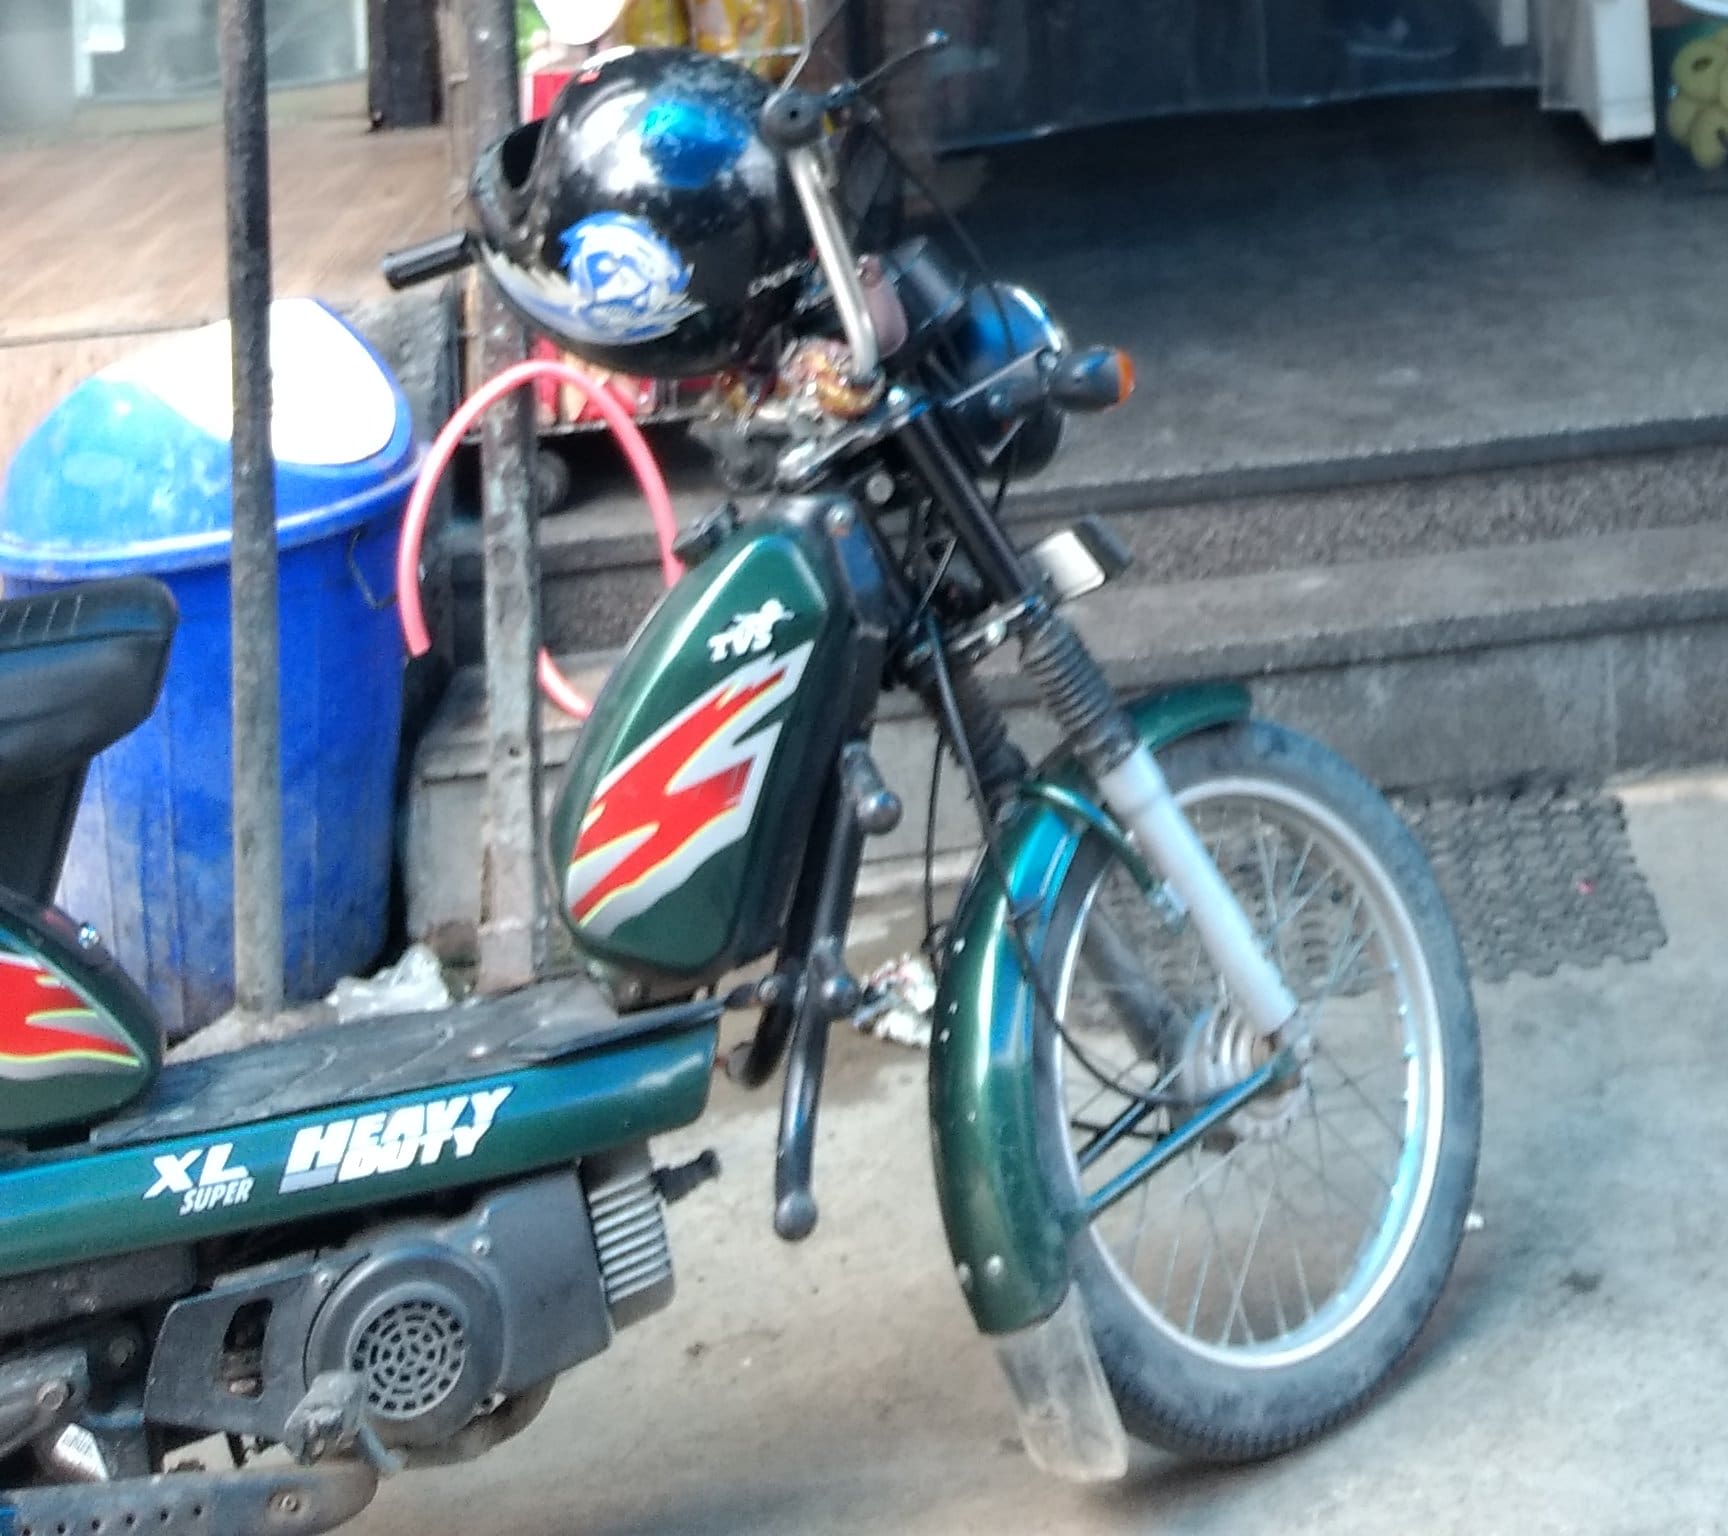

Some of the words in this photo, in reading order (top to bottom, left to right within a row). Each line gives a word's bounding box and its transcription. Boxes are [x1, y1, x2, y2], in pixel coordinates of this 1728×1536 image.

[707, 626, 773, 664] TVS
[284, 1085, 514, 1178] HEAVY
[337, 1122, 494, 1184] DUTY
[142, 1142, 250, 1200] XL
[179, 1176, 254, 1216] SUPER
